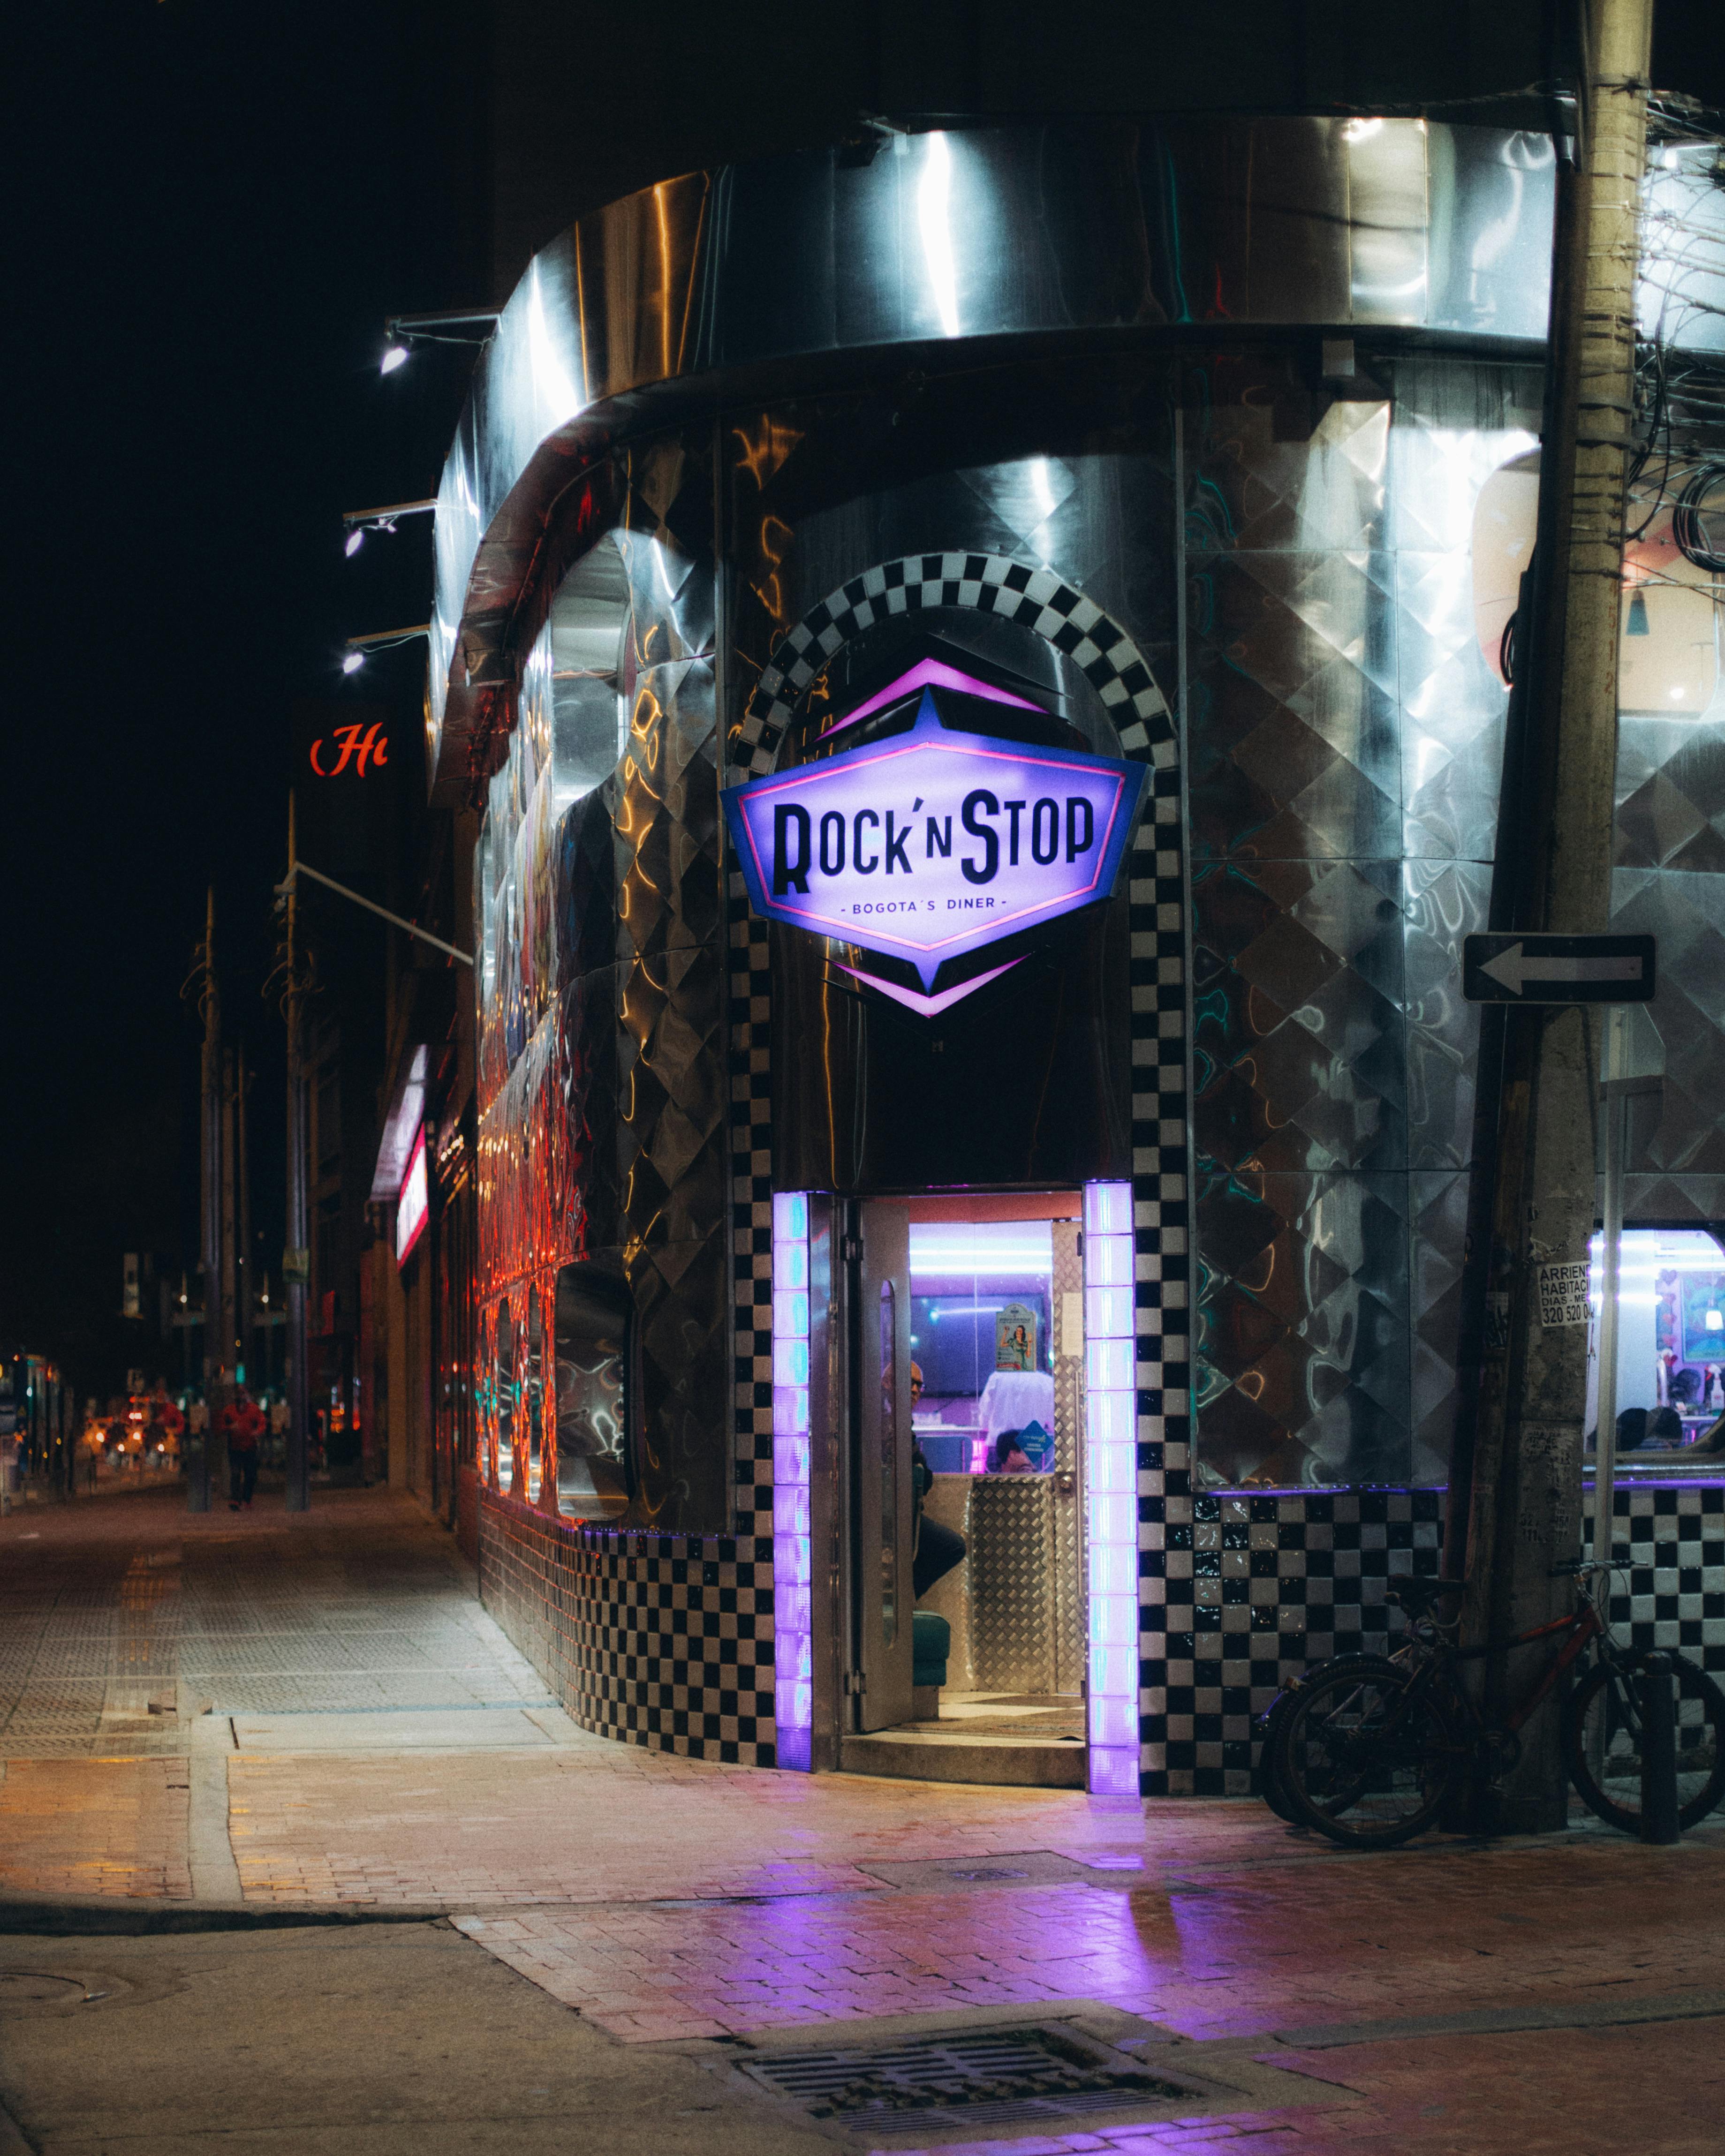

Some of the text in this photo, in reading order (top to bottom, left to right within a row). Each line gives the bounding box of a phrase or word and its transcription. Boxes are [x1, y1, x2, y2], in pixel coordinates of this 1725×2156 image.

[961, 789, 1094, 885] STOP
[947, 897, 995, 910] DINER
[1542, 1296, 1567, 1306] DIAS
[1543, 1303, 1590, 1324] 320 520 0
